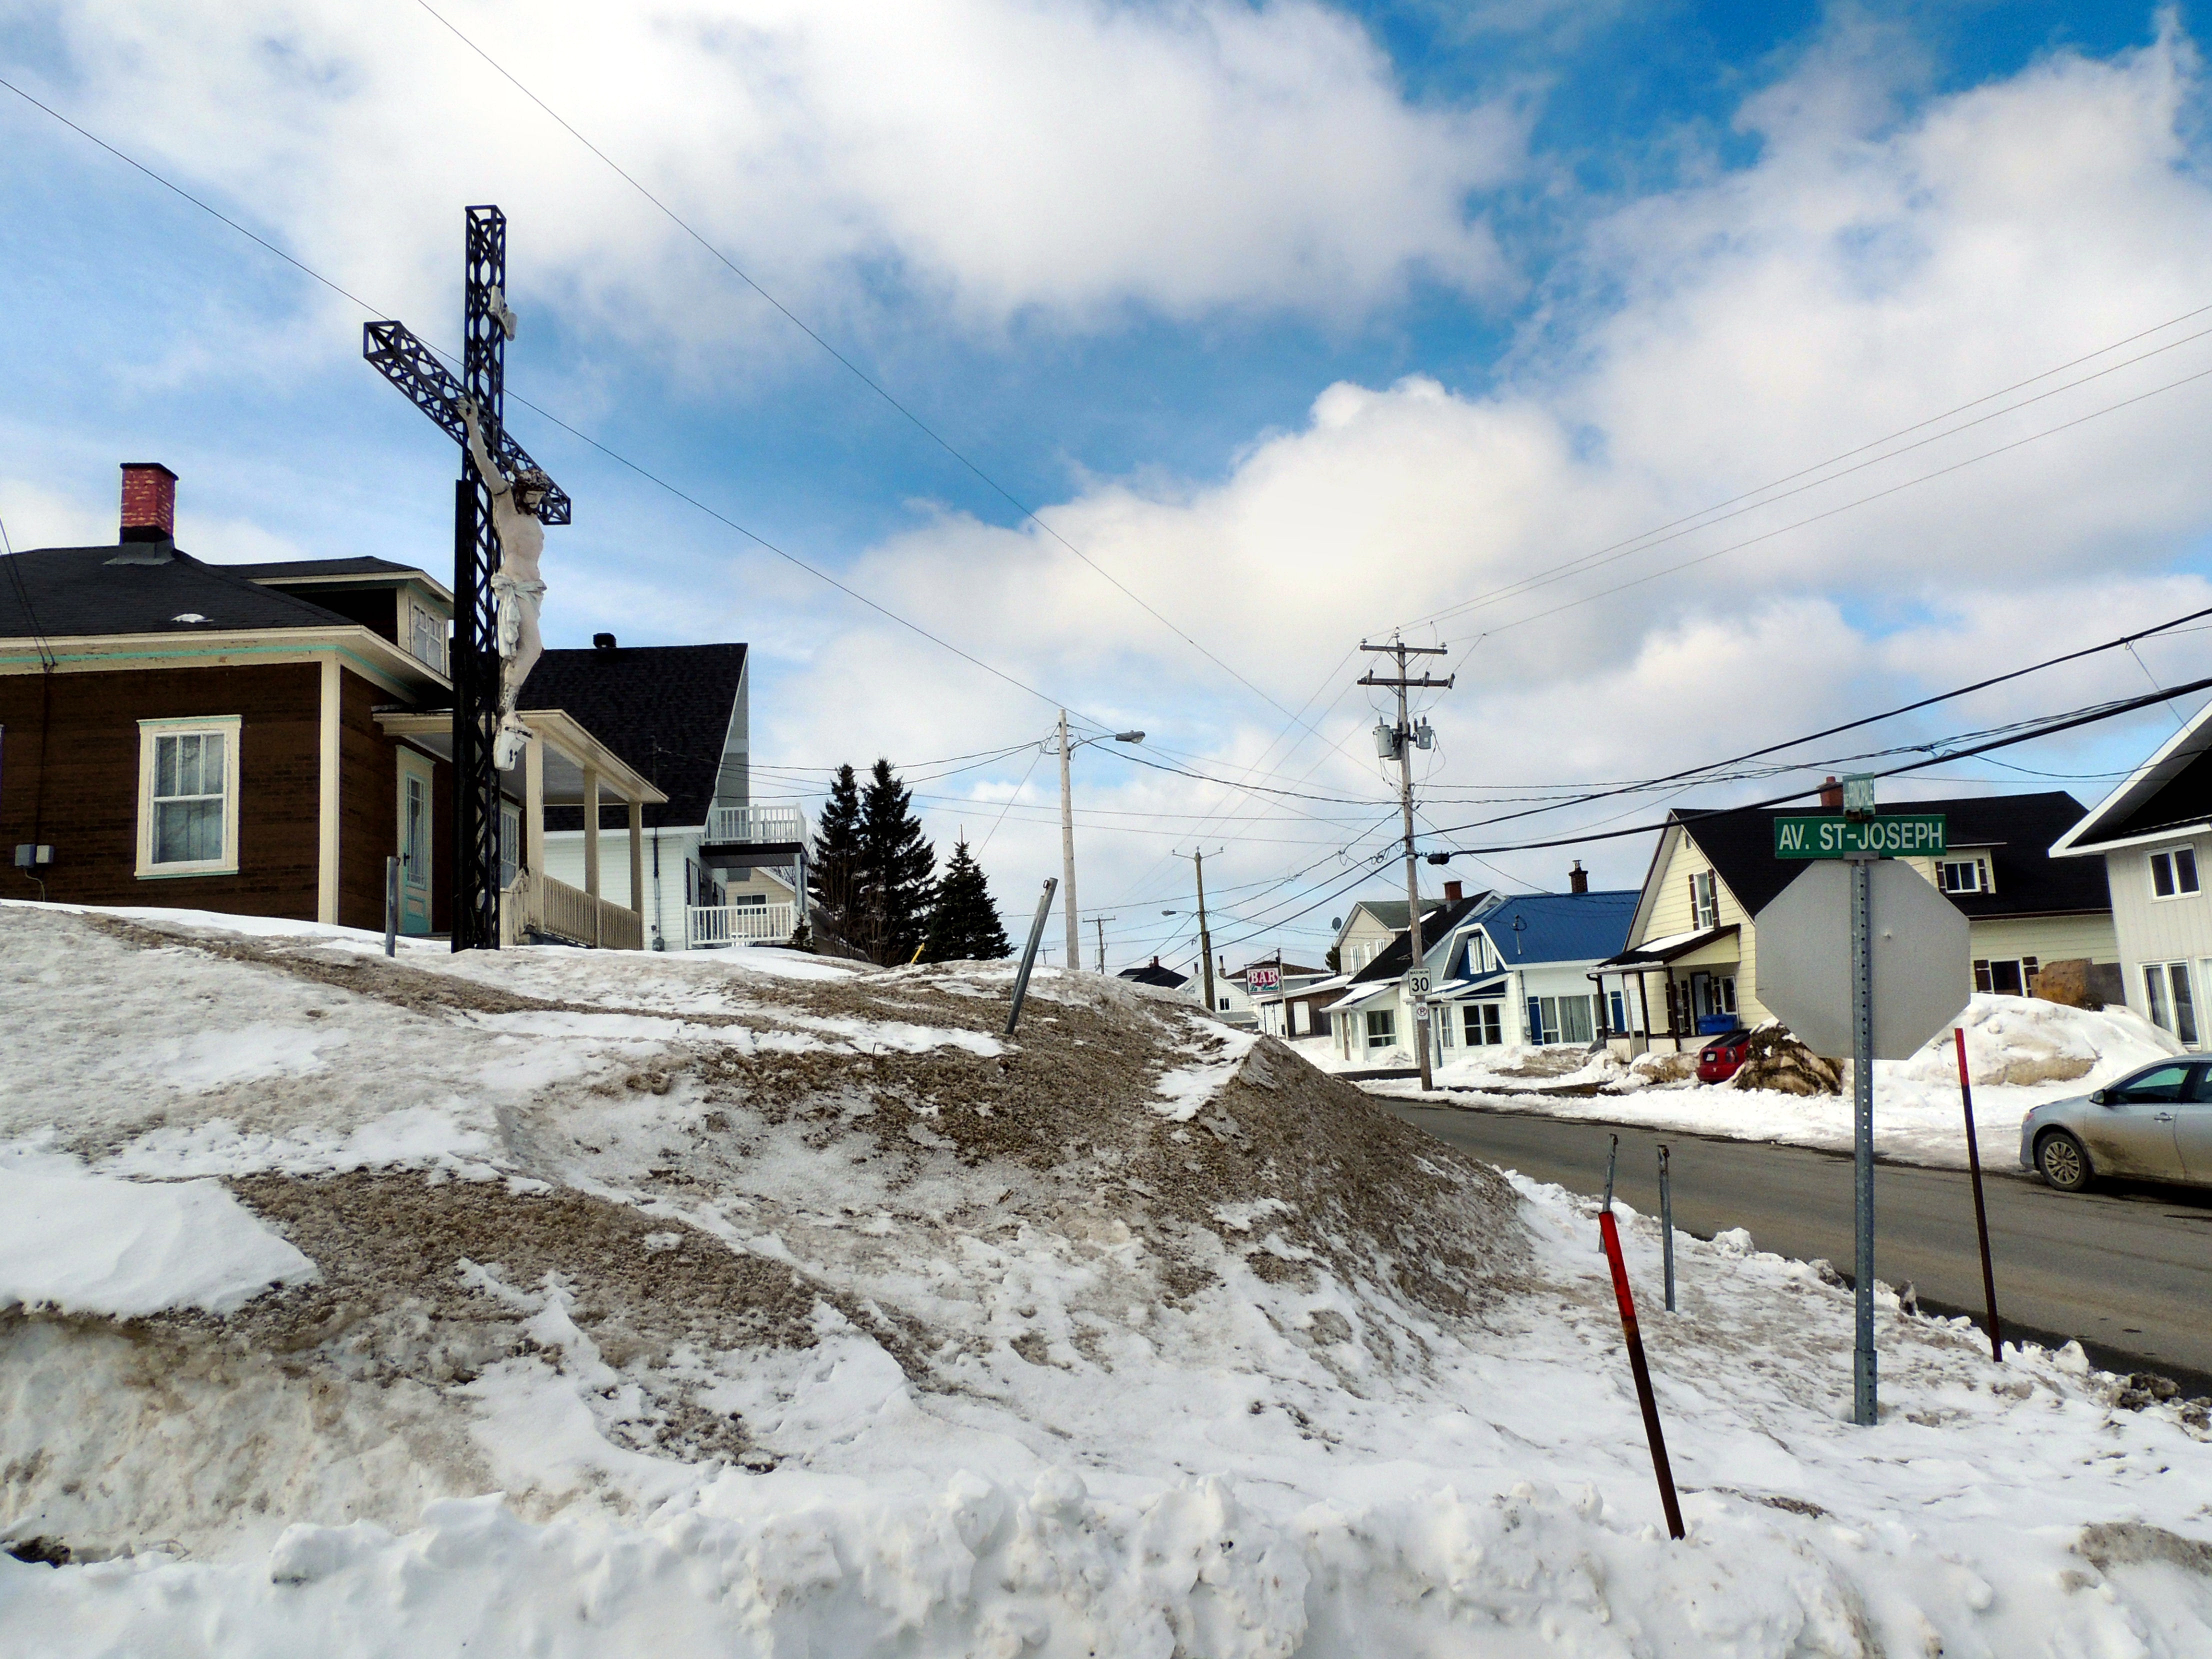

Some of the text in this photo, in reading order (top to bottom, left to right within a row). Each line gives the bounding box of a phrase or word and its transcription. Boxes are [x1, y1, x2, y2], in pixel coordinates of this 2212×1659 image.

[1779, 822, 1942, 850] AV. ST-JOSEPH
[1250, 970, 1276, 983] BAR
[1412, 977, 1429, 992] 30
